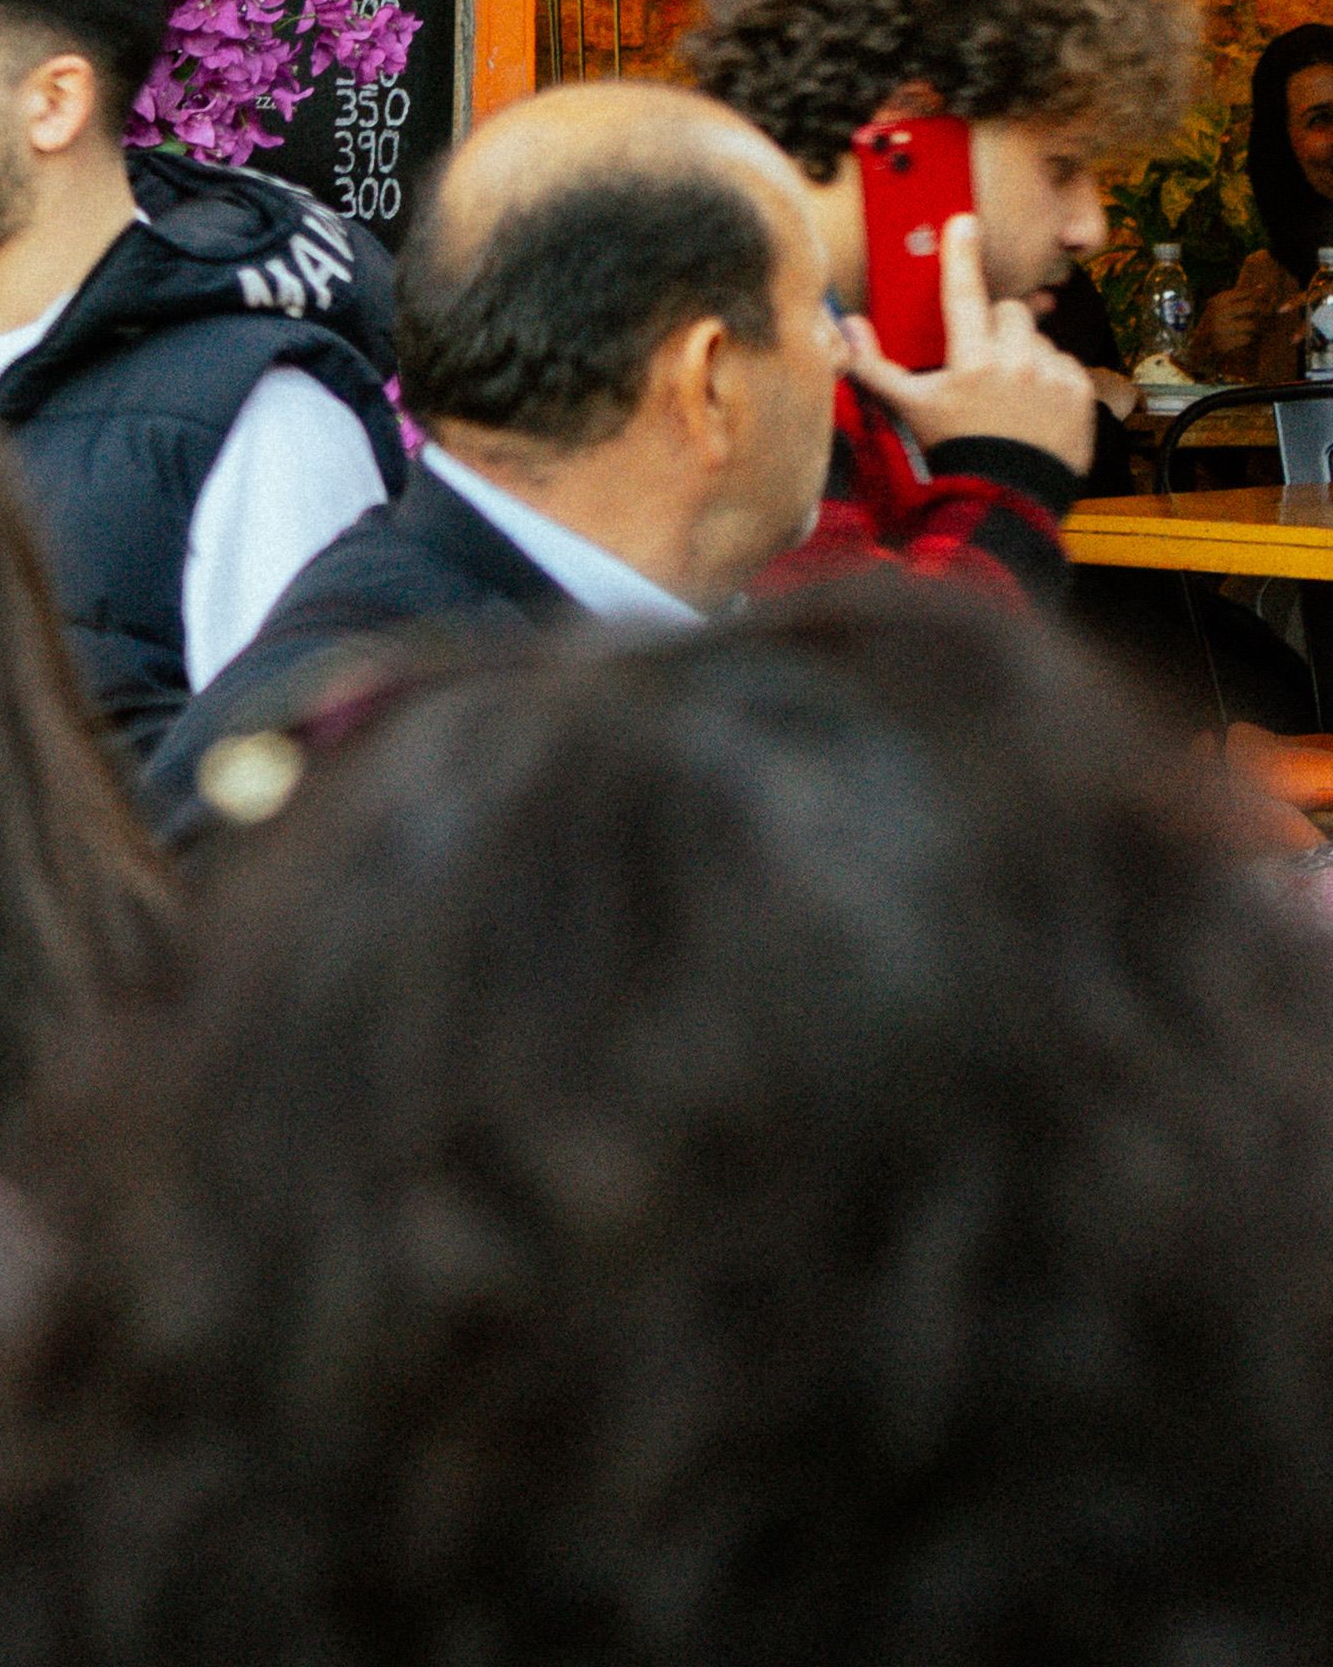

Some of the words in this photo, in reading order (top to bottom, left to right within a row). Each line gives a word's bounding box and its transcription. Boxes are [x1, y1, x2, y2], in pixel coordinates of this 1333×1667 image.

[333, 83, 411, 128] 350
[333, 128, 401, 175] 390
[333, 176, 402, 220] 300
